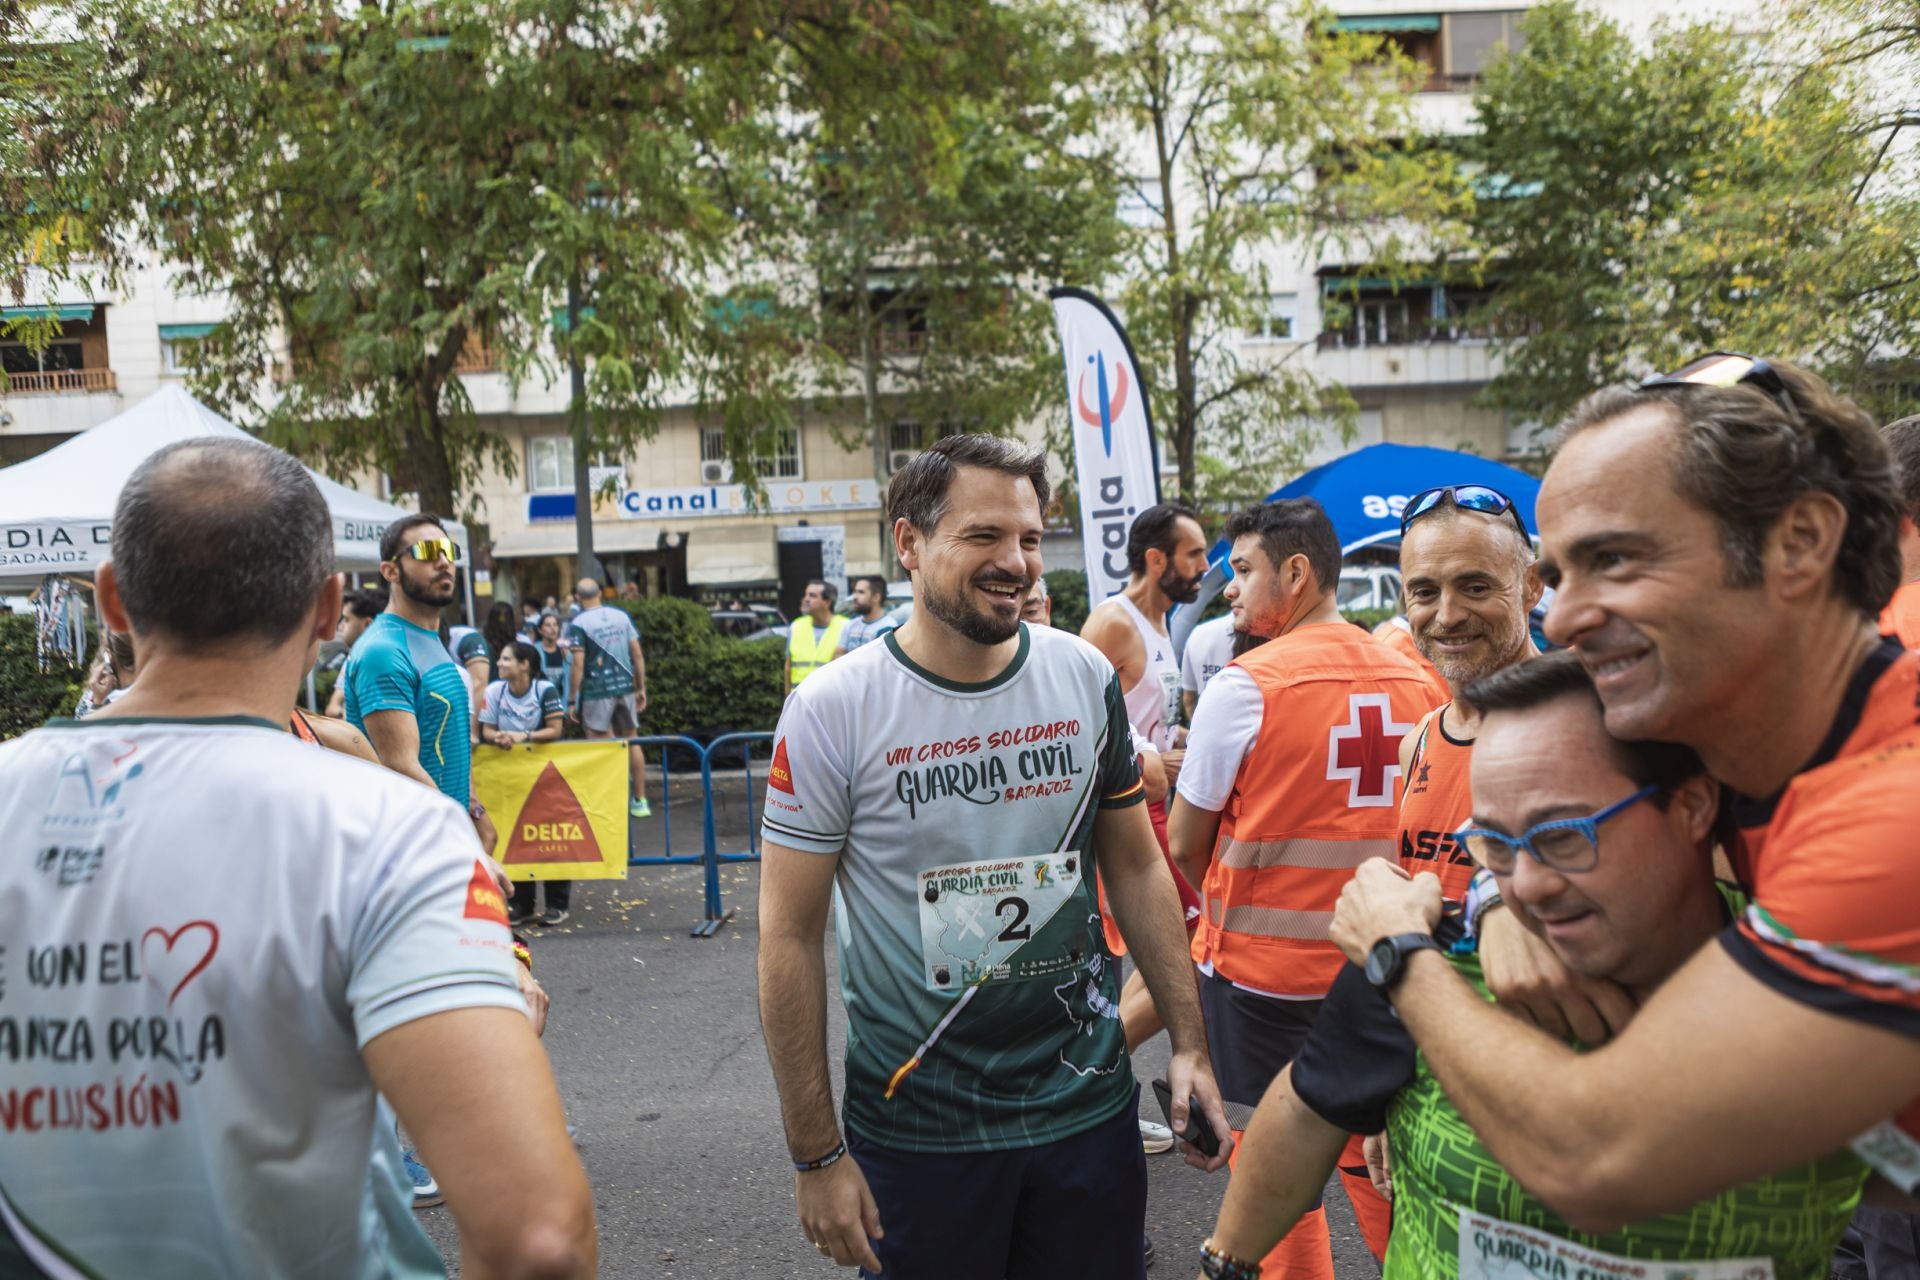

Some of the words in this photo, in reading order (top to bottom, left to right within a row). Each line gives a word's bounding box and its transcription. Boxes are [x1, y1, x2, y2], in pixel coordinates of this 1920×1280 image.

[624, 487, 718, 513] Canal
[728, 482, 861, 509] BOKE
[1361, 494, 1417, 519] as
[0, 525, 74, 550] DIA
[886, 745, 914, 768] VIII
[917, 735, 982, 763] CROSS
[986, 719, 1081, 750] SOLIDARIO
[896, 755, 1008, 820] GUARDIA
[1018, 741, 1083, 781] CIVIL
[1003, 778, 1073, 804] BADAJOZ
[522, 822, 585, 842] DELTA
[974, 861, 1024, 874] SOLIDARIO
[988, 871, 1024, 887] CIVIL
[995, 896, 1031, 942] 2
[98, 938, 141, 984] EL
